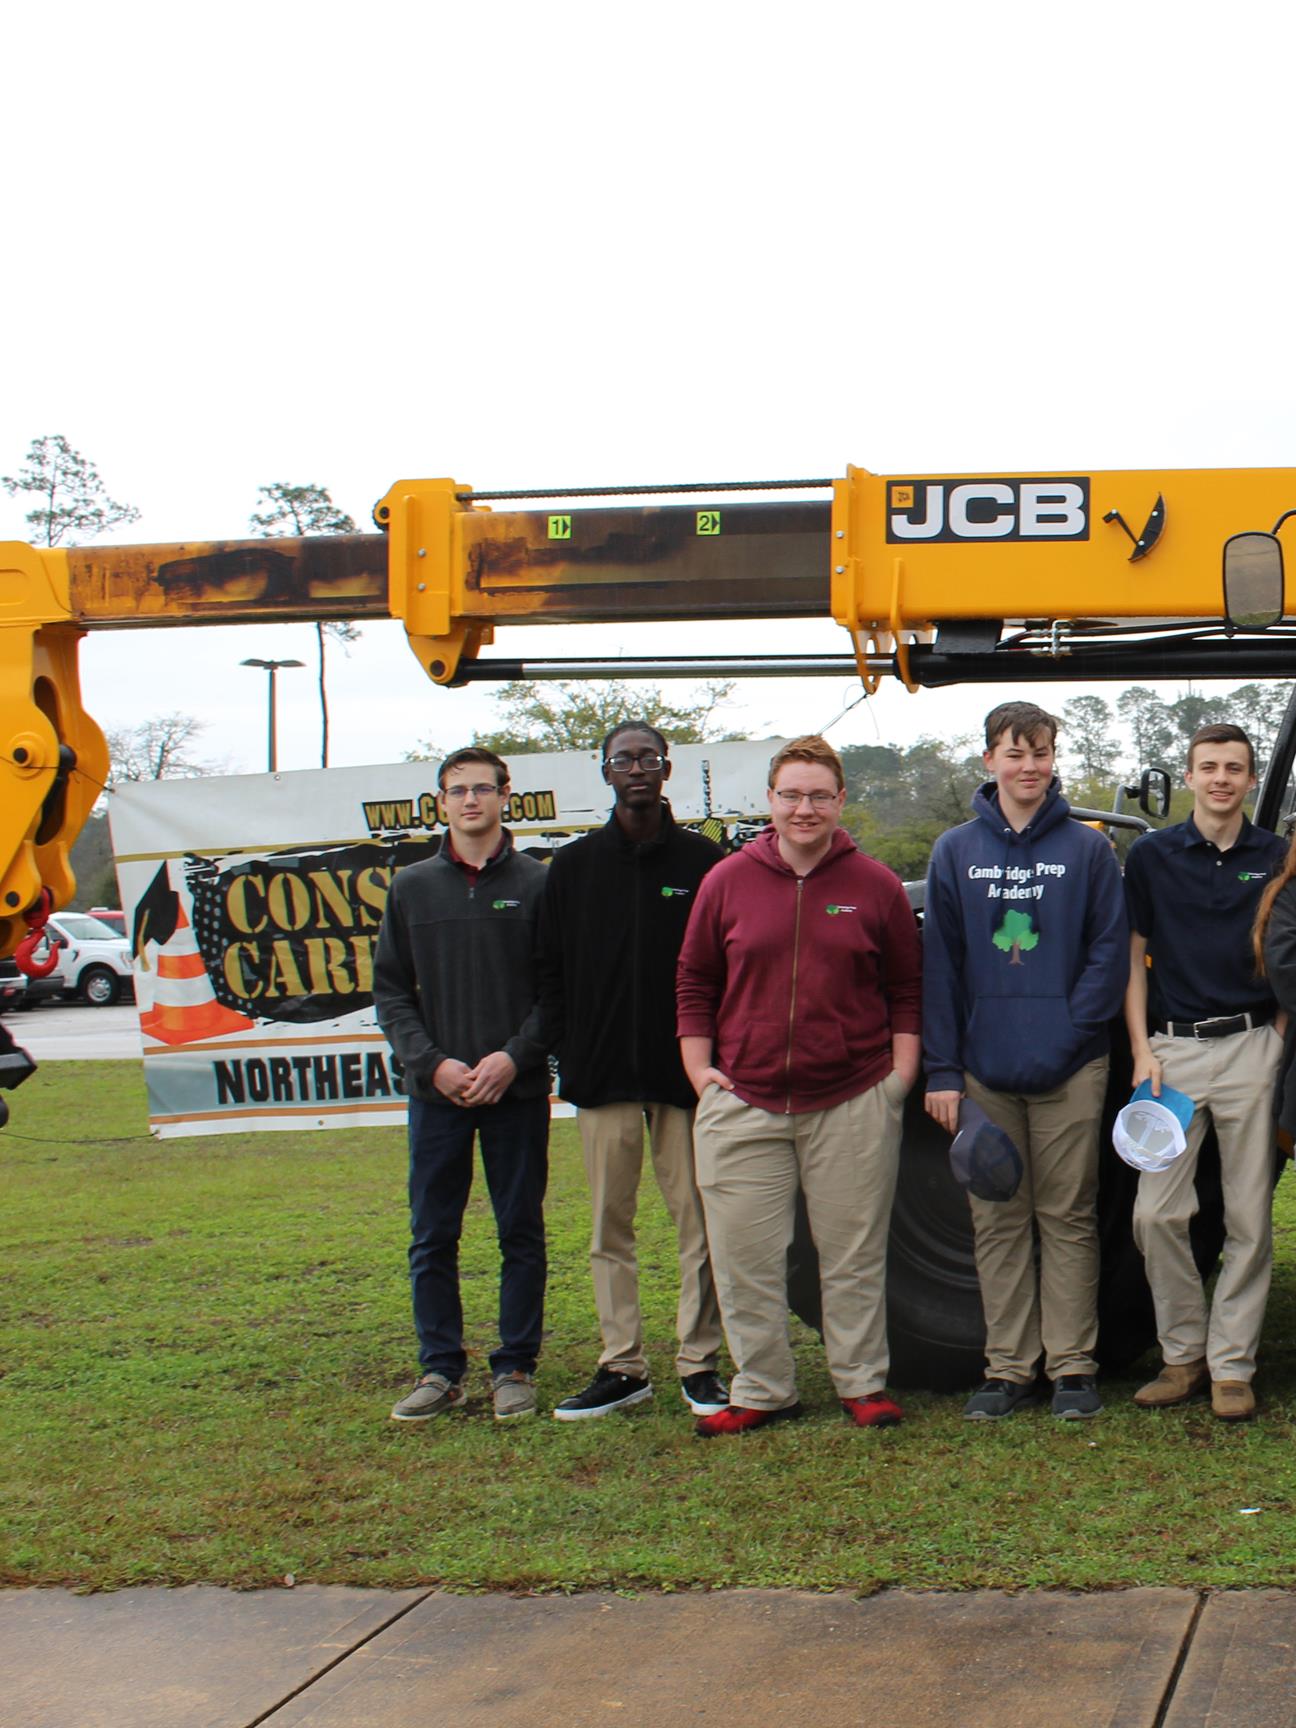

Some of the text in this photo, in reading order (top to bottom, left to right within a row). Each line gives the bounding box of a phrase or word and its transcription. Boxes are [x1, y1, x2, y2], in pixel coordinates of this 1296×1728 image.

[891, 483, 1086, 538] JCB
[552, 520, 560, 535] 1
[699, 515, 710, 532] 2
[1036, 863, 1066, 878] Prep
[226, 866, 406, 934] CONS
